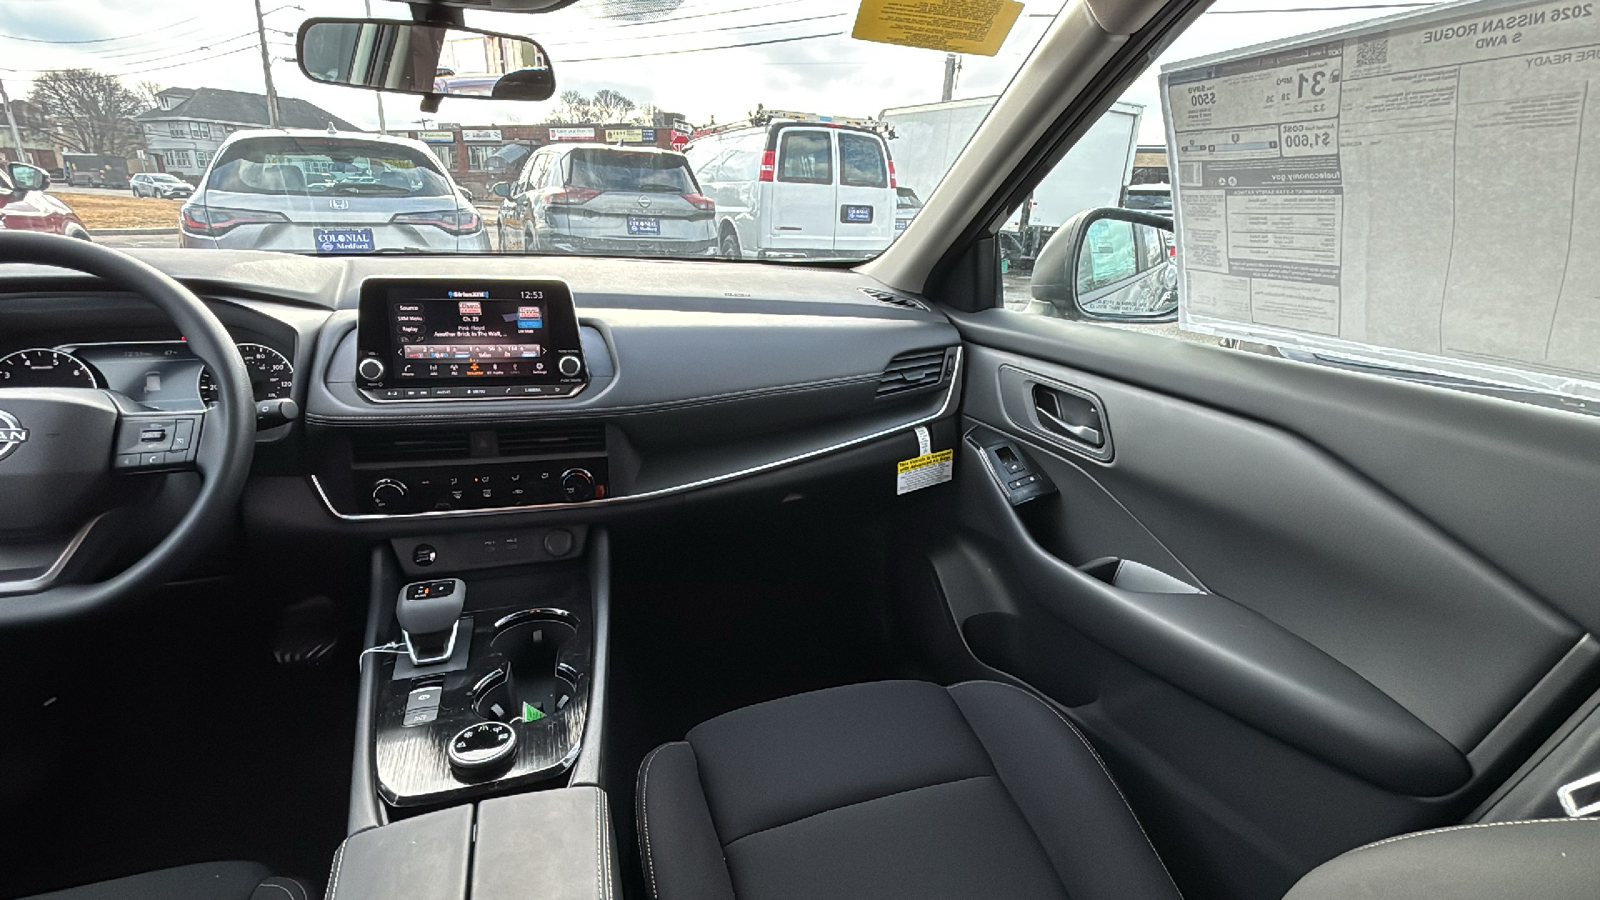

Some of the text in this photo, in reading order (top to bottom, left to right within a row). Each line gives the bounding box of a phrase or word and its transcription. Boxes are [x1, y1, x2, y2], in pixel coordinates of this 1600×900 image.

[318, 234, 369, 243] COLONIAL
[520, 291, 544, 299] 12:53
[910, 457, 926, 465] Vehicle
